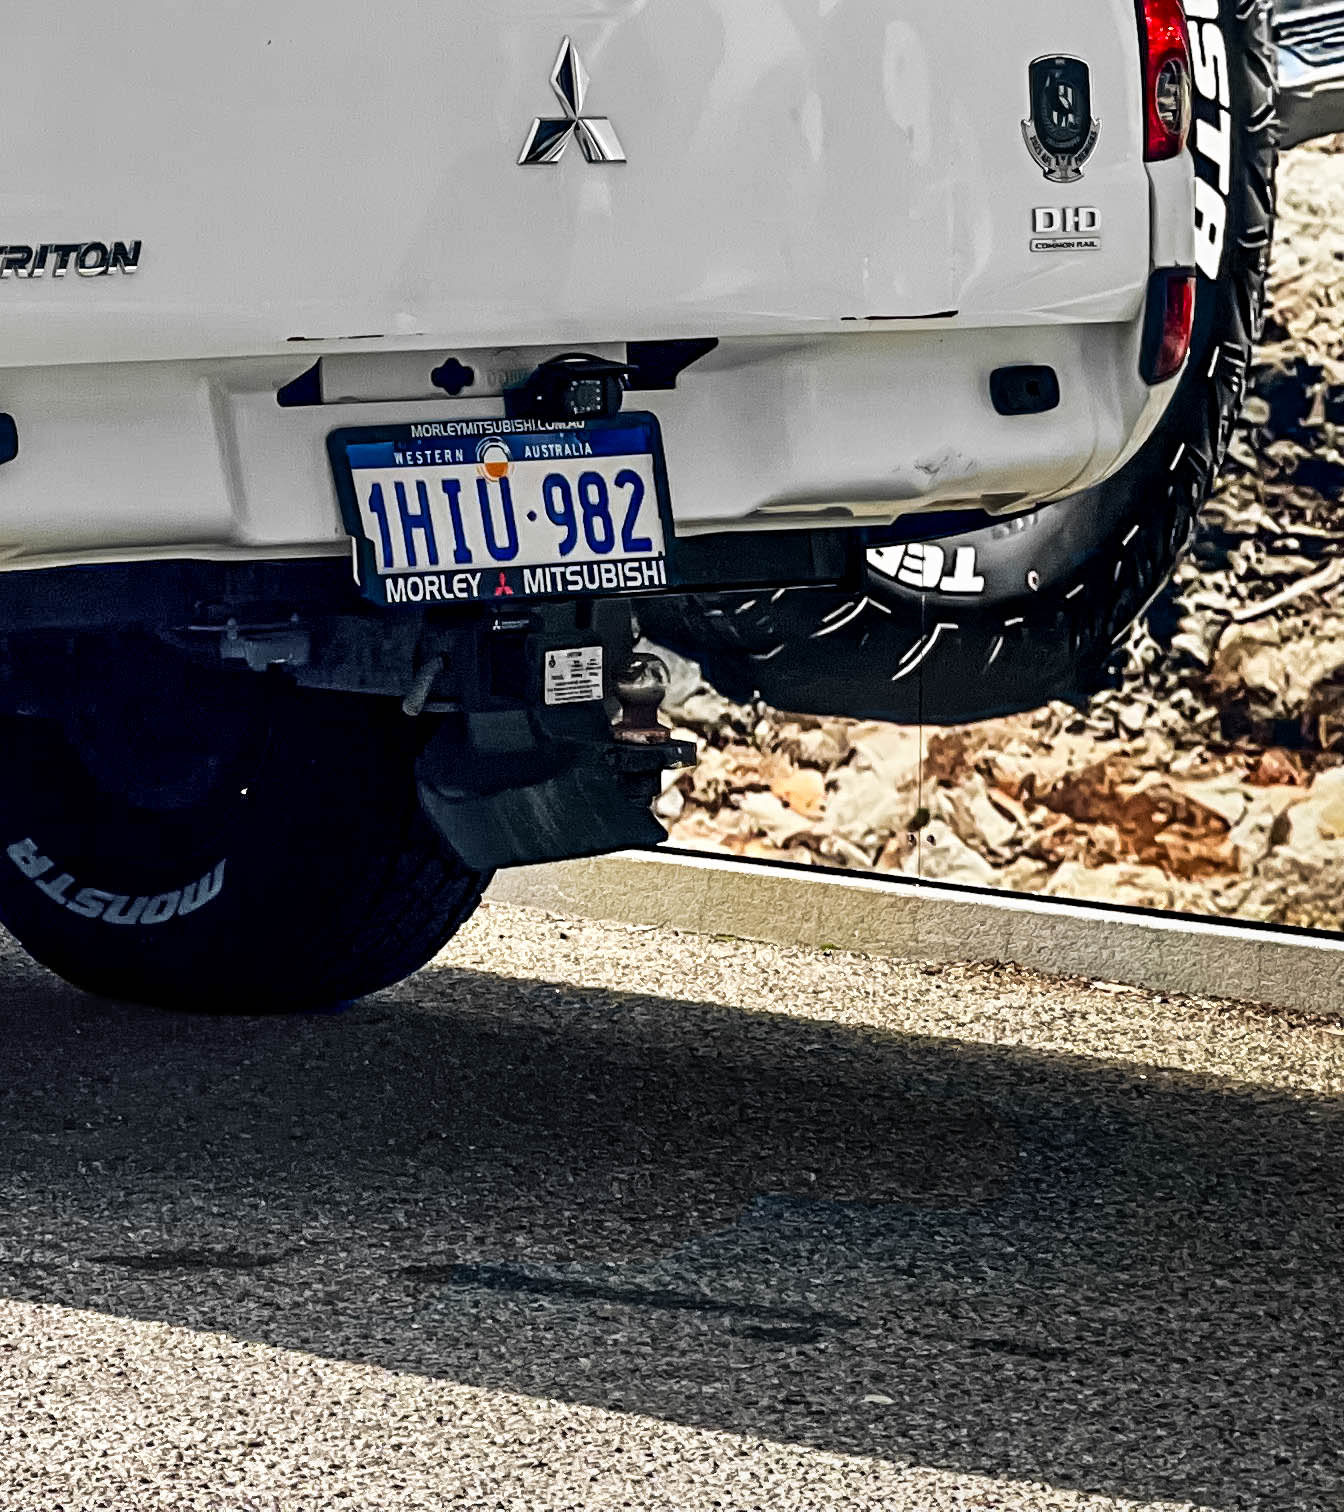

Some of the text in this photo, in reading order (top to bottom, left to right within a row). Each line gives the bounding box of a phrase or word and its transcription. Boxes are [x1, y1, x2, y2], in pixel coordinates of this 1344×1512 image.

[1034, 240, 1098, 249] COMMON RAIL
[393, 442, 593, 465] WESTERN AUSTRALIA
[385, 559, 667, 603] MORLEY MITSUBISHI
